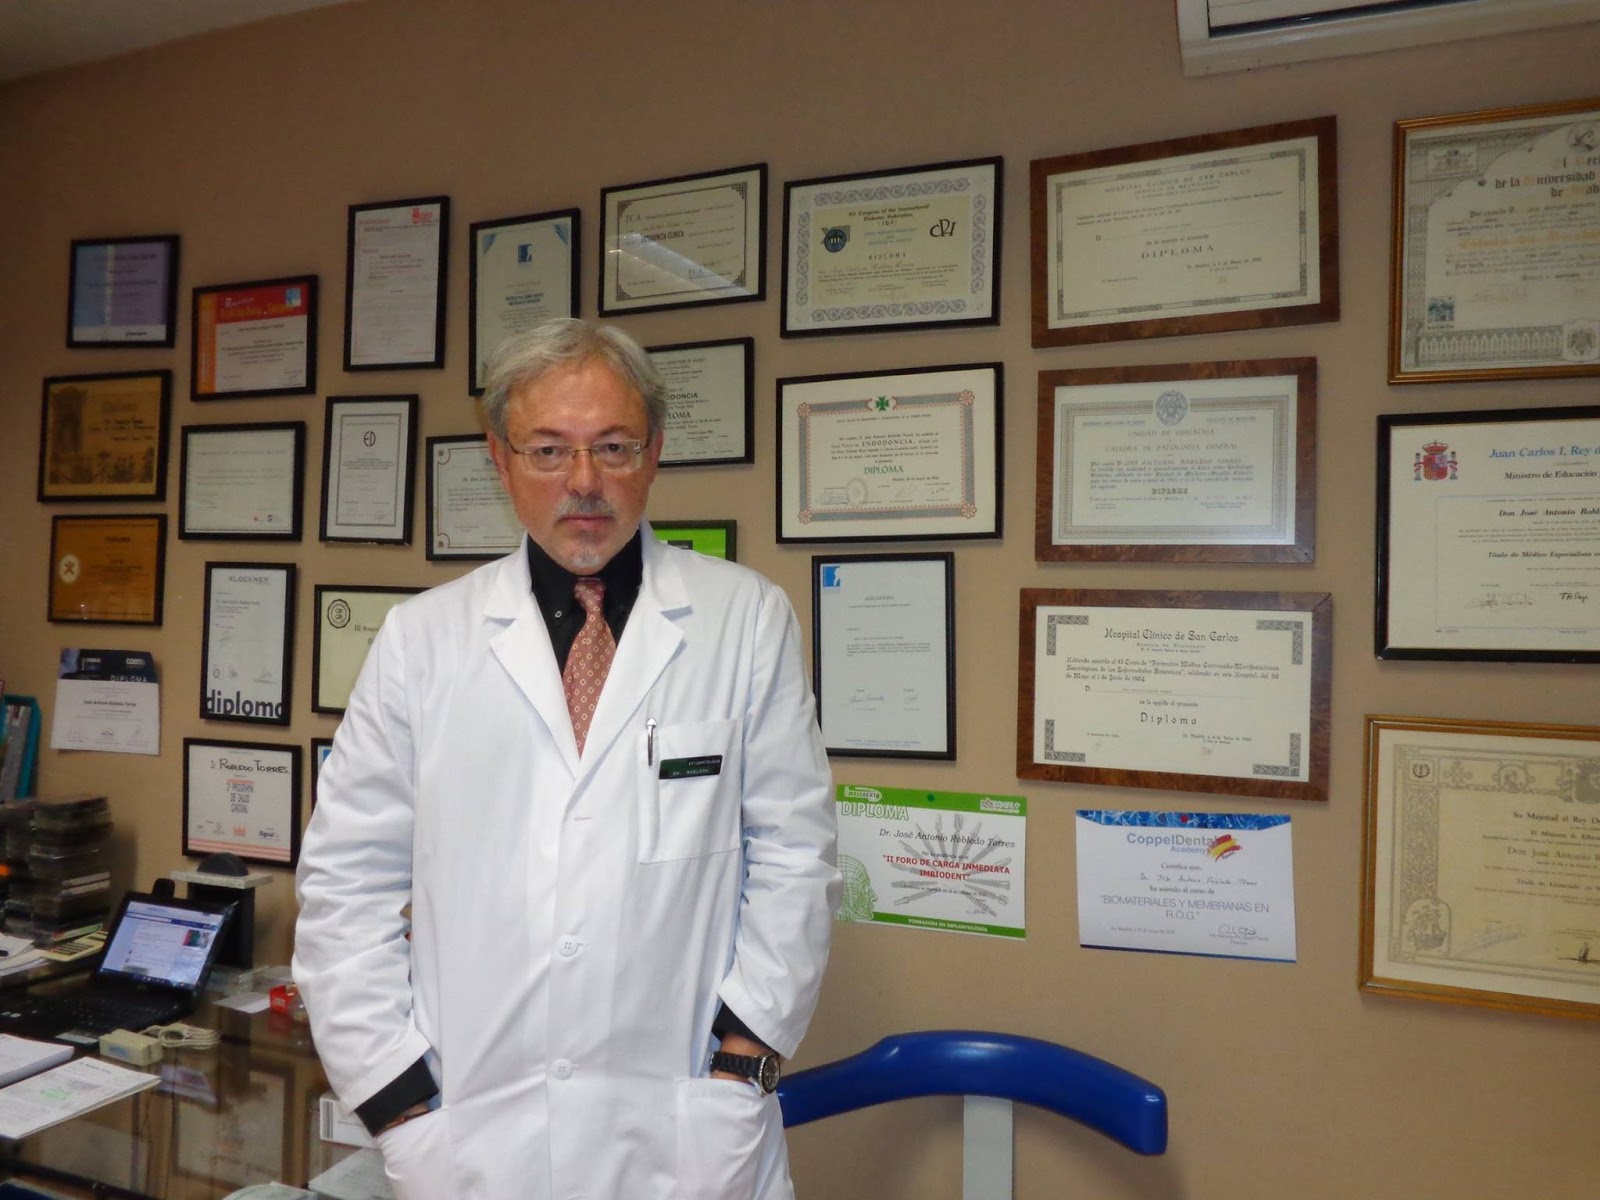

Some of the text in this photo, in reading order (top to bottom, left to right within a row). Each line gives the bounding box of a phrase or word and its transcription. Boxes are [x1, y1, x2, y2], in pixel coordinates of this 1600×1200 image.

[1495, 179, 1507, 188] de
[1140, 244, 1215, 259] DIPLOMA
[1488, 448, 1516, 458] Juan
[1519, 447, 1556, 457] Carlos
[1570, 445, 1592, 456] Rey
[864, 464, 905, 474] DIPLOMA
[1504, 471, 1541, 479] Ministro
[1554, 470, 1598, 478] Educación
[1104, 627, 1240, 642] Hospital Clínico de San Carlos
[1140, 711, 1197, 725] Diploma
[841, 801, 909, 820] DIPLOMA
[879, 828, 1016, 847] Dr. José Antonio Robledo Torres
[1126, 832, 1218, 847] CoppelDental
[895, 855, 918, 865] FORO
[919, 858, 931, 866] DE
[931, 860, 960, 870] CARGA
[962, 863, 1011, 874] INMEDIATA
[1178, 899, 1186, 907] Y
[1187, 900, 1253, 912] MEMBRANAS
[1254, 902, 1271, 912] EN
